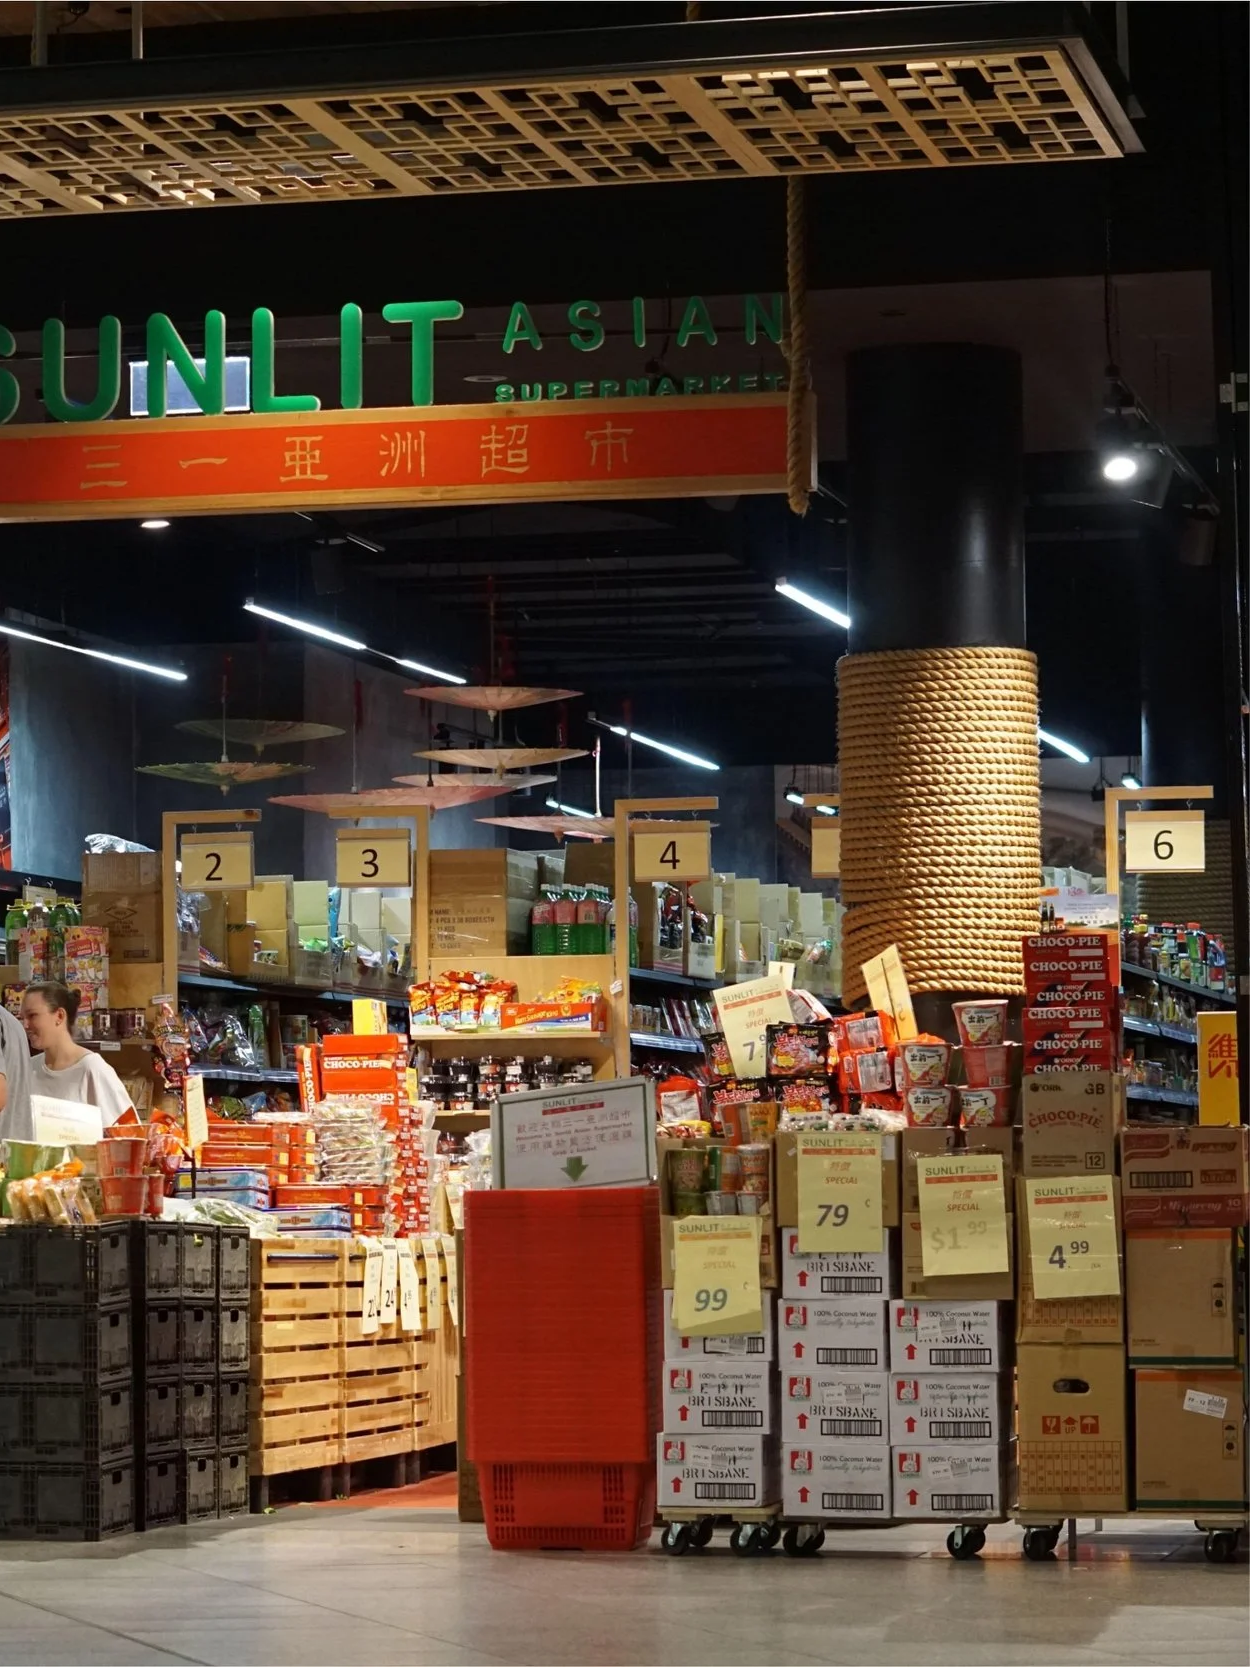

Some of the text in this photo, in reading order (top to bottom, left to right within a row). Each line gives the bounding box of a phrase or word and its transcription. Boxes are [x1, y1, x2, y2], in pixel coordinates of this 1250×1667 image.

[502, 294, 784, 353] ASIAN
[495, 372, 786, 402] SUPERMARKET
[1153, 830, 1174, 860] 6
[659, 840, 681, 870] 4
[204, 853, 223, 882] 2
[361, 849, 380, 878] 3
[722, 990, 754, 1003] SUNLIT
[745, 1017, 772, 1030] SPECIAL
[542, 1098, 576, 1108] SUNLIT
[802, 1139, 844, 1147] SUNLIT
[1089, 1155, 1101, 1166] 12
[925, 1165, 965, 1176] SUNLIT
[825, 1176, 858, 1185] SPECIAL
[1035, 1187, 1075, 1197] SUNLIT
[946, 1203, 980, 1212] SPECIAL
[816, 1204, 849, 1227] 79
[679, 1224, 720, 1233] SUNLIT
[807, 1261, 875, 1273] BRISBANE
[694, 1289, 728, 1312] 99
[688, 1396, 756, 1408] BRISBANE
[810, 1405, 877, 1419] BRISBANE
[920, 1407, 989, 1418] BRISBANE
[682, 1468, 750, 1479] BRISBANE
